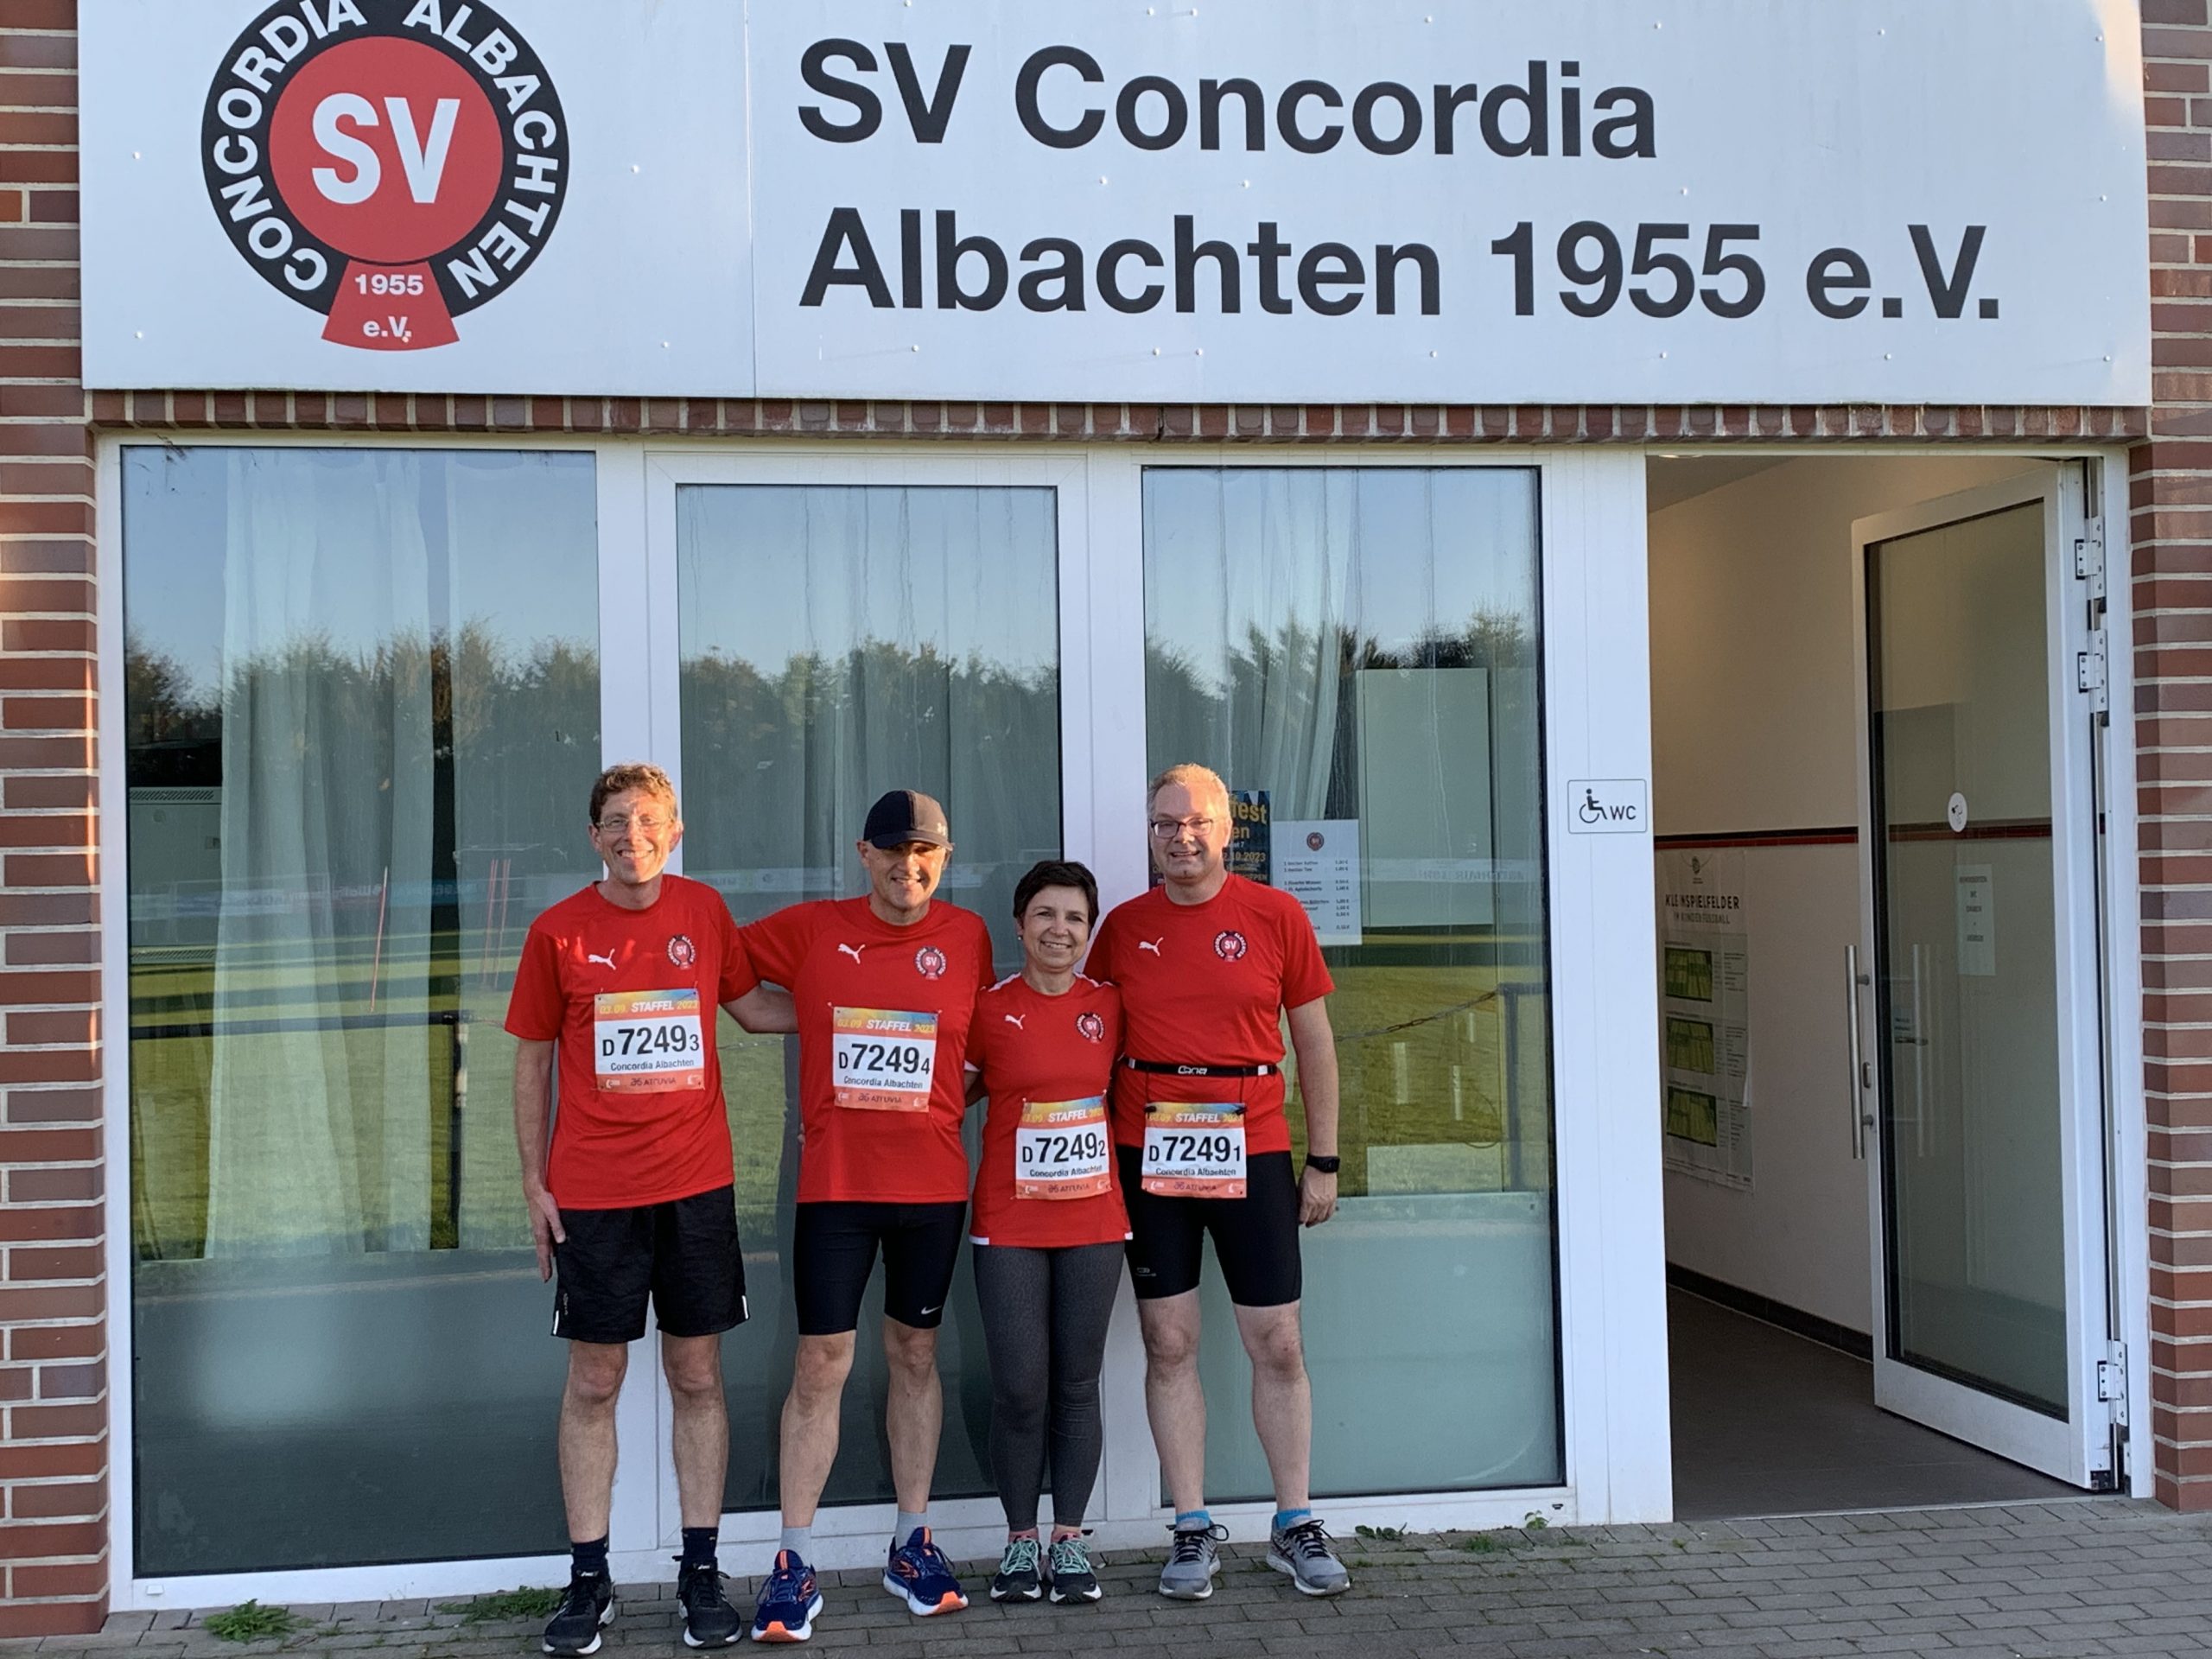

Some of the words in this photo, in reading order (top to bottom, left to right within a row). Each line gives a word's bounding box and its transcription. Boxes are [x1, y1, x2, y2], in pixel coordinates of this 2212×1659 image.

[798, 38, 972, 143] SV
[1015, 46, 1657, 160] Concordia
[213, 0, 368, 291] CONCORDIA
[403, 0, 559, 299] ALBACHTEN
[311, 92, 461, 205] SV
[799, 207, 1440, 316] Albachten
[1491, 221, 1766, 319] 1955
[1807, 224, 1999, 320] e.V.
[354, 274, 424, 296] 1955
[363, 316, 413, 338] e.V.
[1609, 804, 1637, 821] WC
[1224, 940, 1236, 950] SV
[925, 956, 938, 966] SV
[630, 1000, 675, 1013] STAFFEL
[866, 1020, 912, 1032] STAFFEL
[610, 1060, 653, 1071] Concordia
[655, 1059, 695, 1069] Albachten
[843, 1076, 882, 1086] Concordia
[884, 1078, 923, 1089] Albachten
[1048, 1109, 1088, 1122] STAFFEL
[1174, 1112, 1221, 1123] STAFFEL
[1029, 1168, 1069, 1178] Concordia
[1155, 1167, 1195, 1176] Concordia
[1197, 1167, 1236, 1176] Albachten
